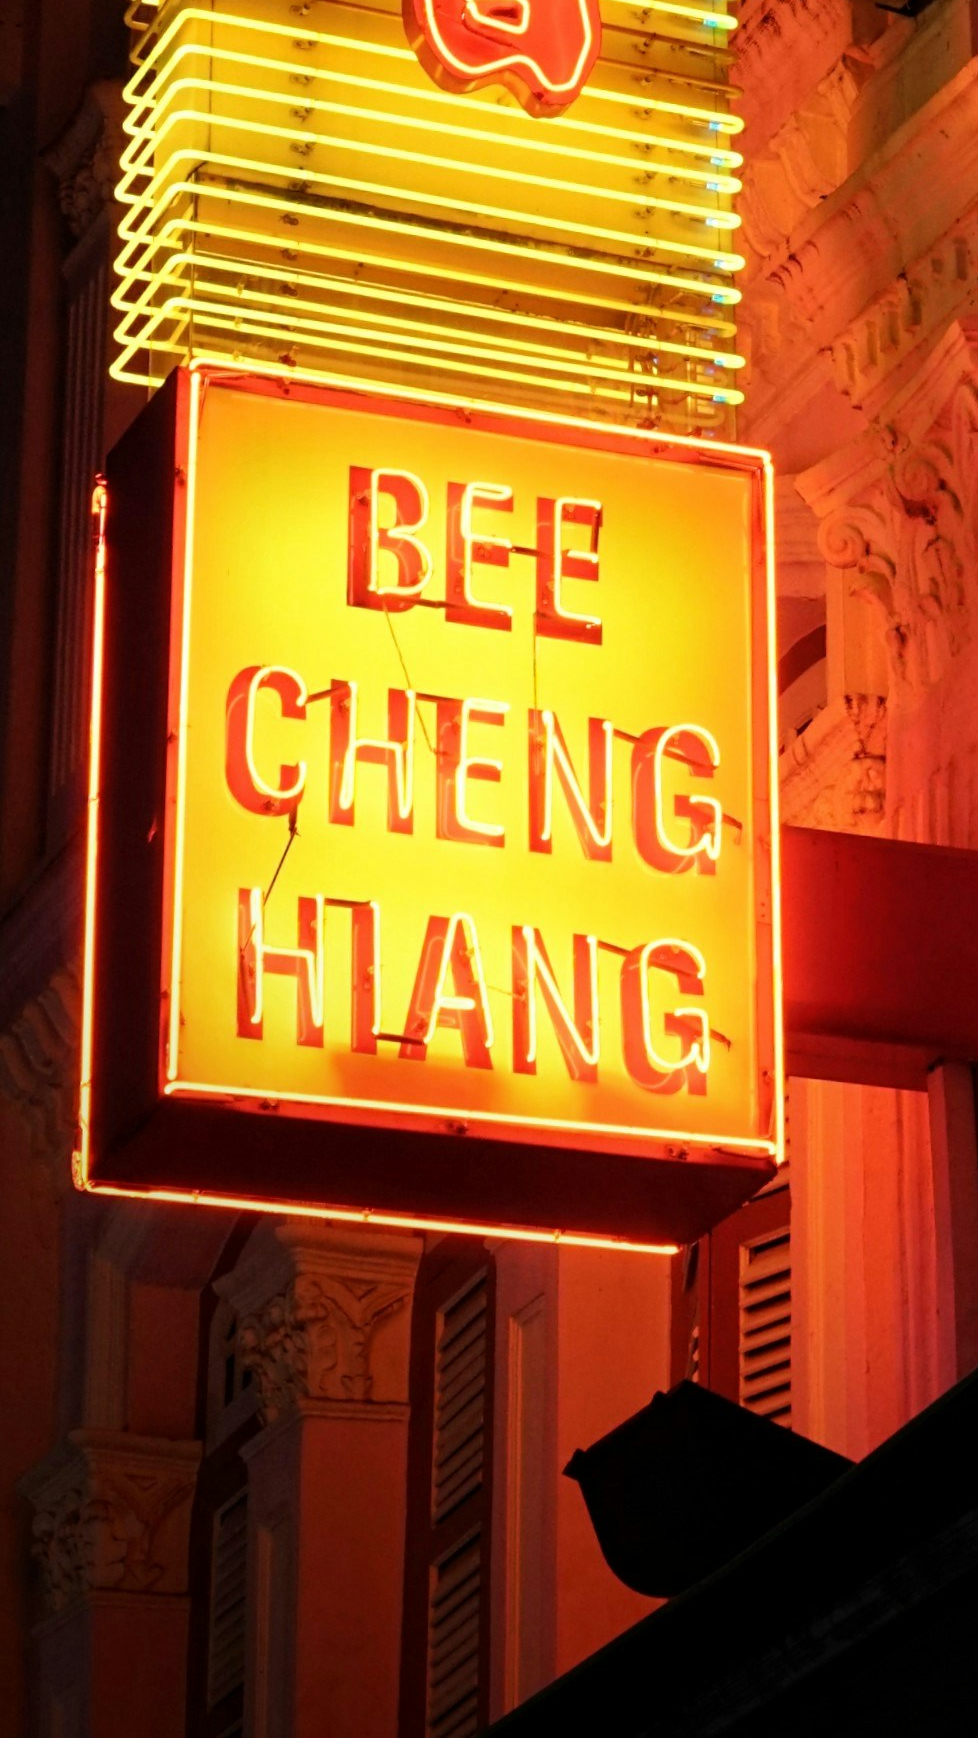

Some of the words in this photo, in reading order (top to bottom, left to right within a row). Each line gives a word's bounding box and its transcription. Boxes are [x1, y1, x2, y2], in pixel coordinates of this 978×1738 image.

[346, 464, 604, 646] BEE
[224, 664, 726, 877] CHENG
[235, 886, 712, 1097] HIANG
